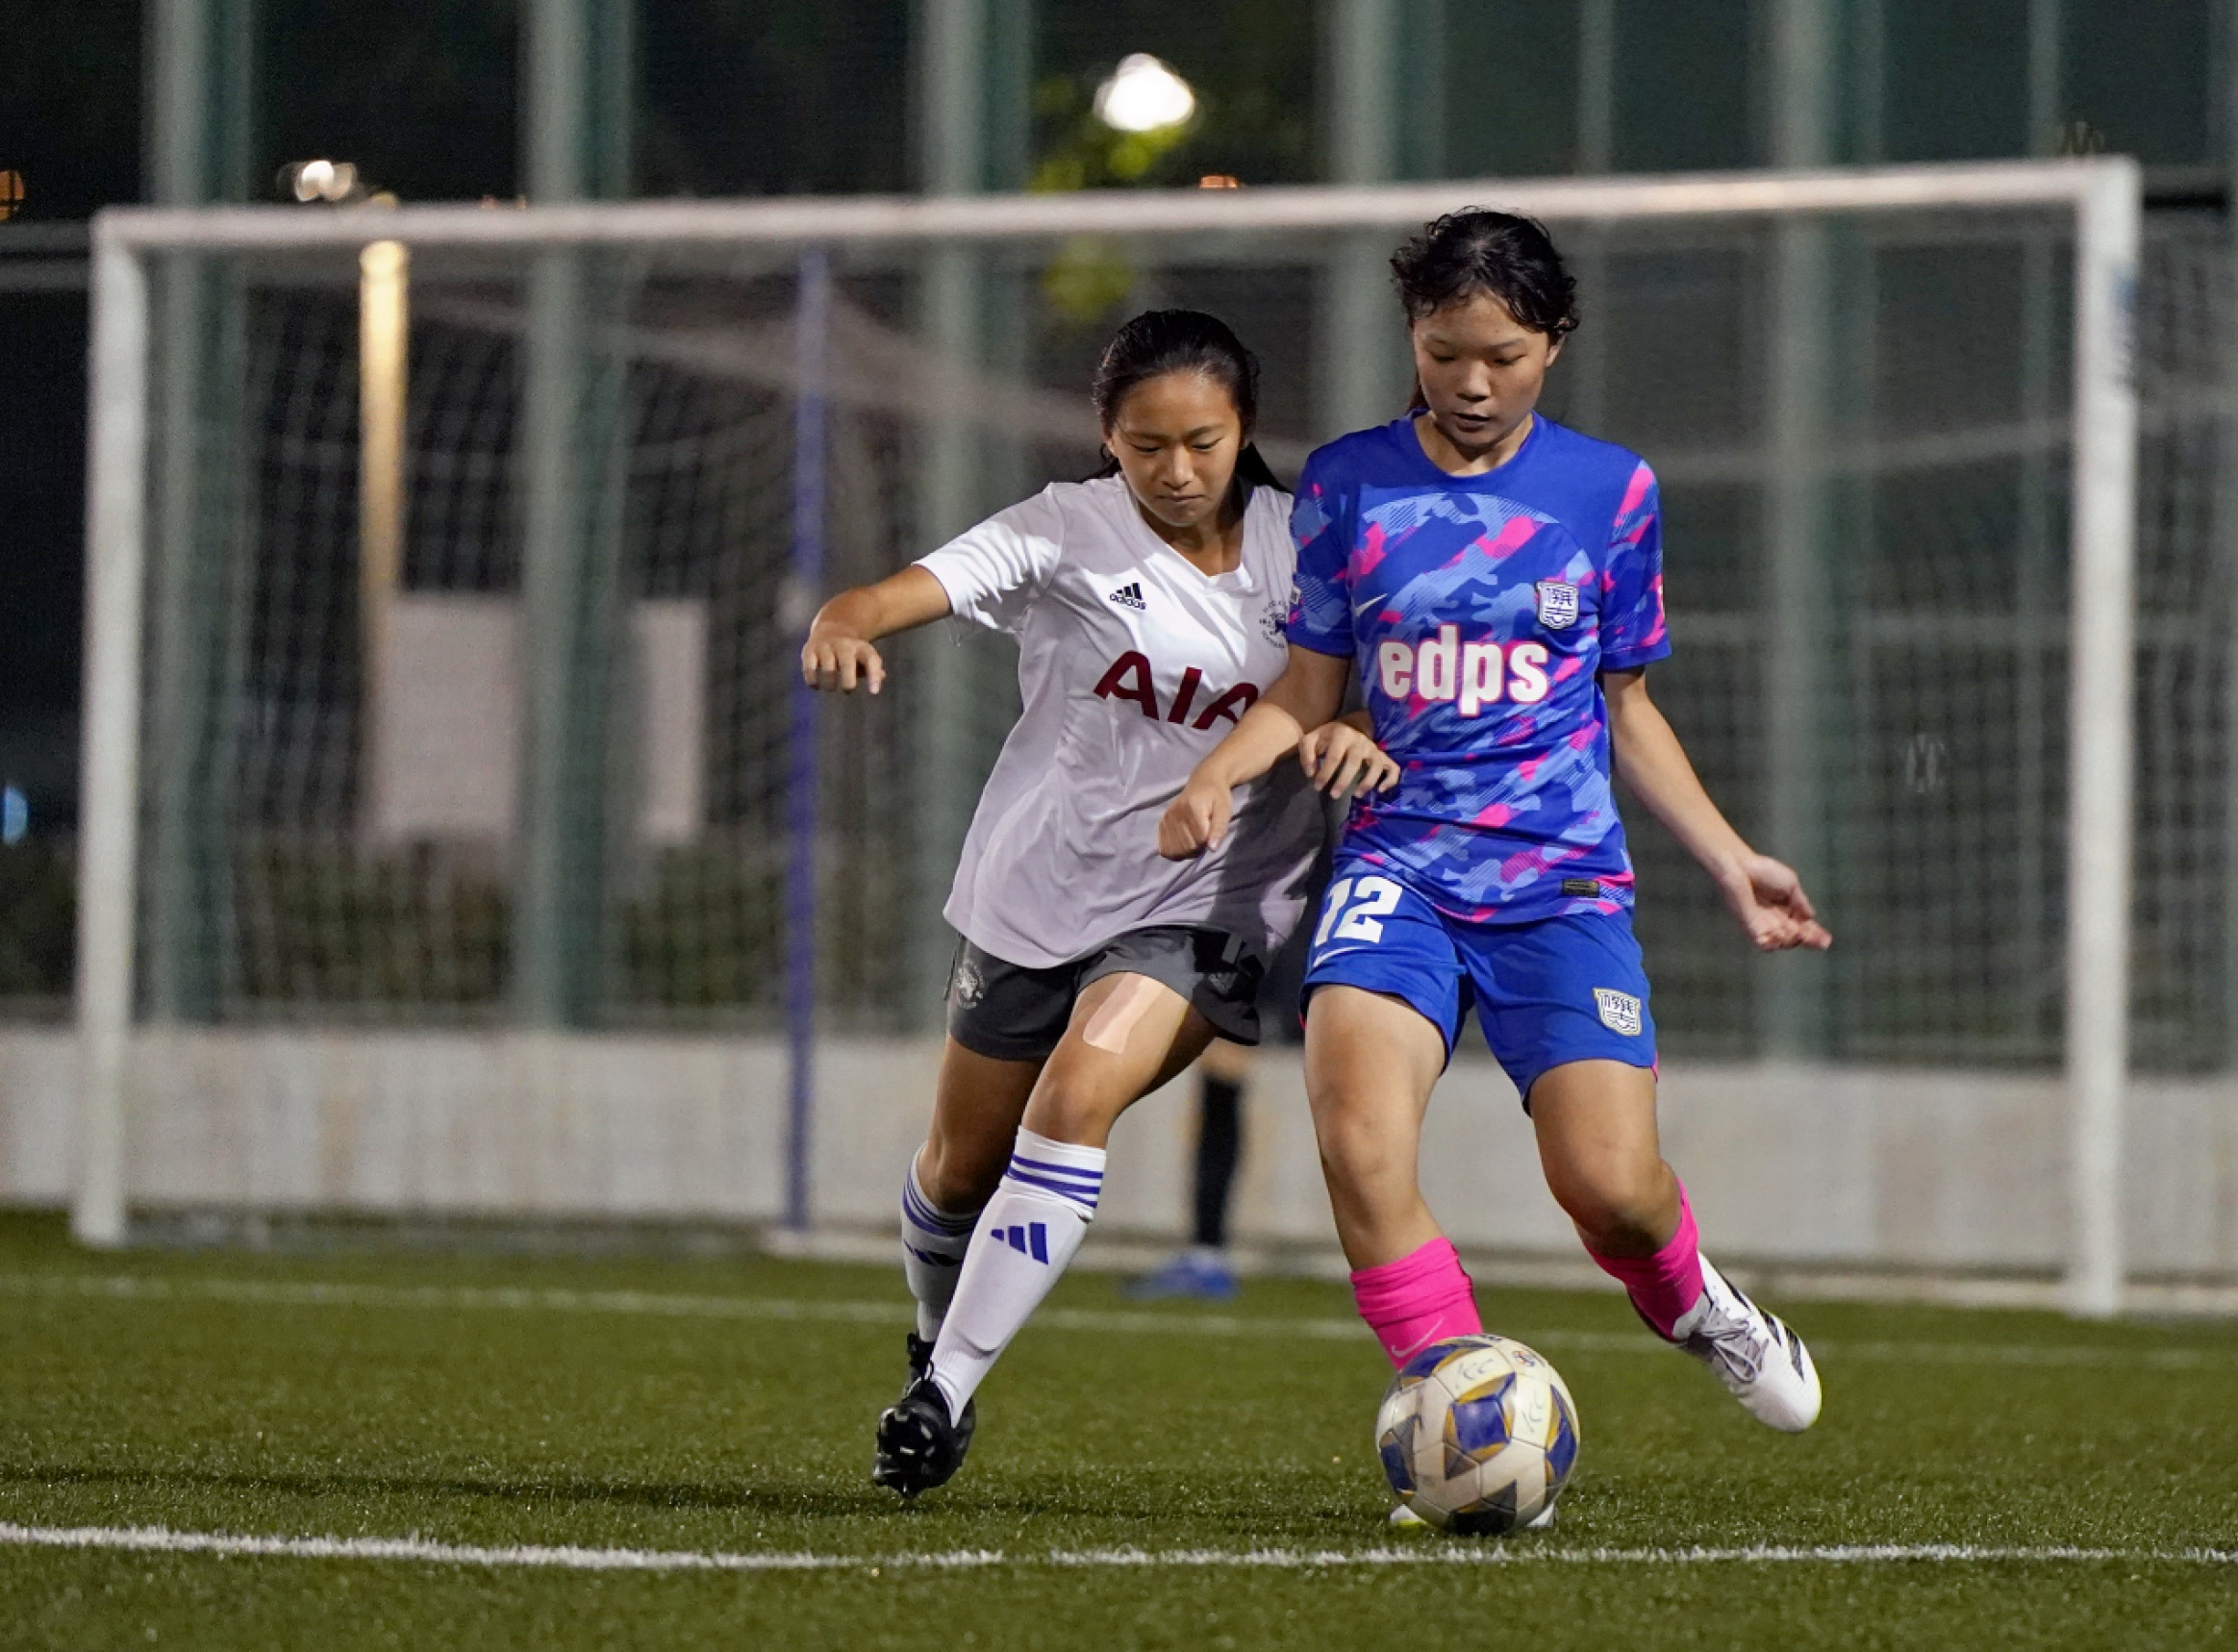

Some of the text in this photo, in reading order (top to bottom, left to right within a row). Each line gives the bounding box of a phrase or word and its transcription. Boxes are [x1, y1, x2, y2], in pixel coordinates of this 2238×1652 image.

[1109, 591, 1147, 611] adidas
[1094, 650, 1259, 730] AIA
[1379, 624, 1549, 716] edps
[1313, 875, 1404, 948] 12
